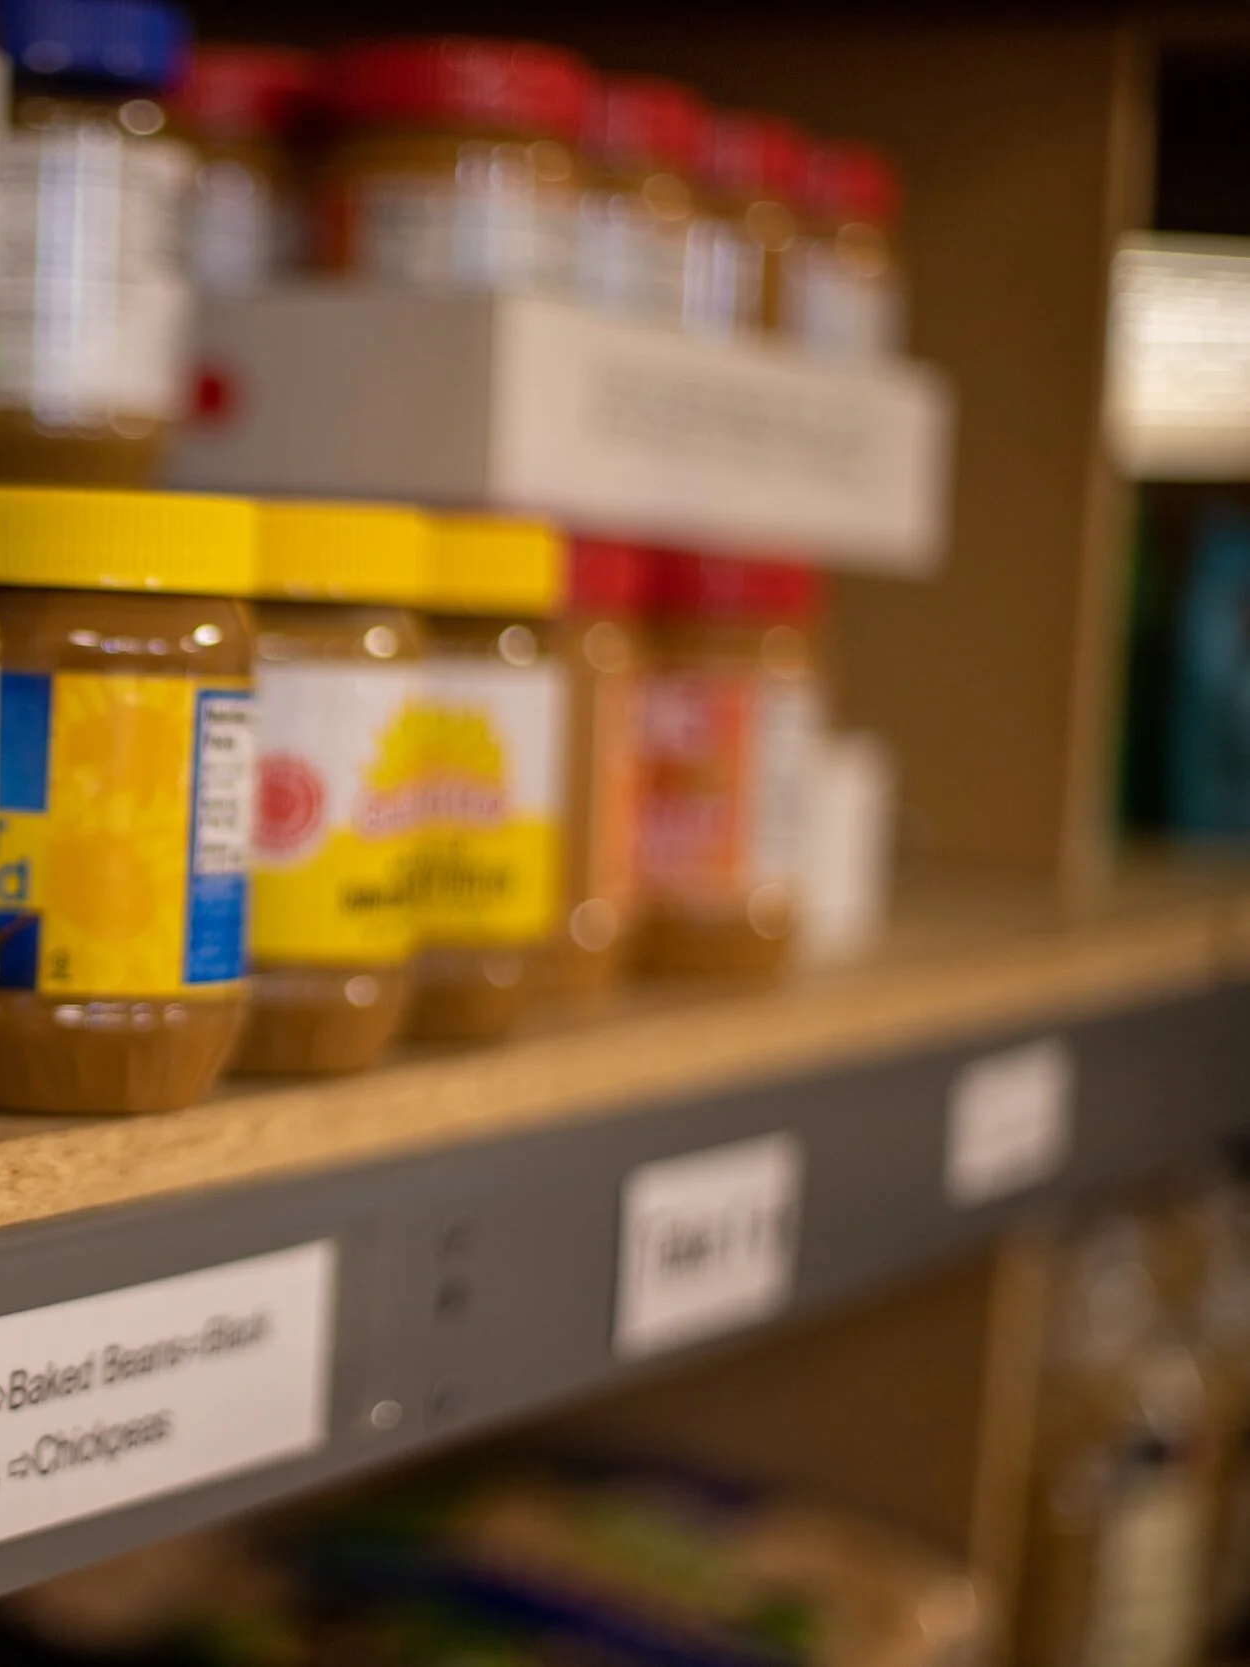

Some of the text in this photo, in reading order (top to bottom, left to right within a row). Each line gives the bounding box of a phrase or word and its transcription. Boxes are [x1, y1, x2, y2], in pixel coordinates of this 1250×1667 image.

[7, 1356, 93, 1411] Baked
[102, 1341, 182, 1384] Beans
[34, 1408, 174, 1476] Chickpeas
